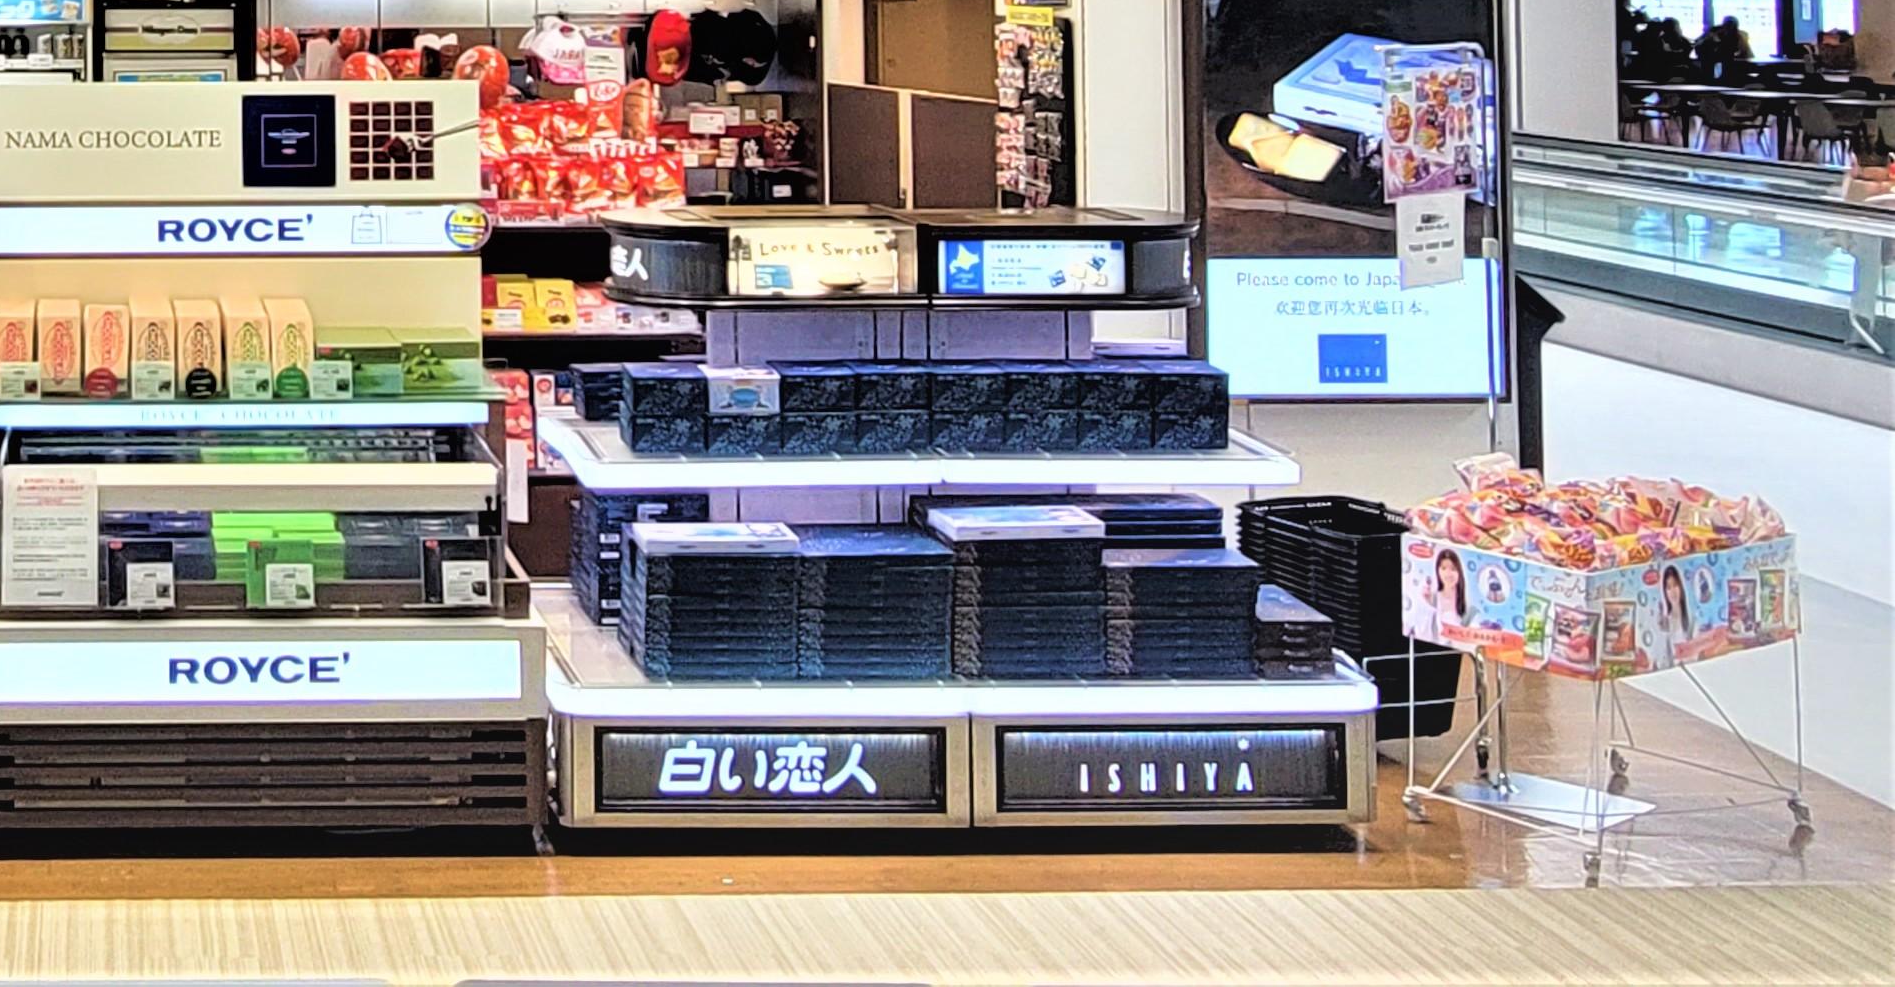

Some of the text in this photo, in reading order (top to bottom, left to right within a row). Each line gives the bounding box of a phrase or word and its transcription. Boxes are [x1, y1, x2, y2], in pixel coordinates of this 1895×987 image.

[5, 129, 222, 149] NAMA CHOCOLATE
[158, 214, 313, 243] ROYCE'
[1236, 272, 1401, 289] Please come to Japa
[168, 652, 350, 684] ROYCE'
[658, 740, 878, 796] 白い恋人
[1079, 762, 1255, 793] ISHIYA
